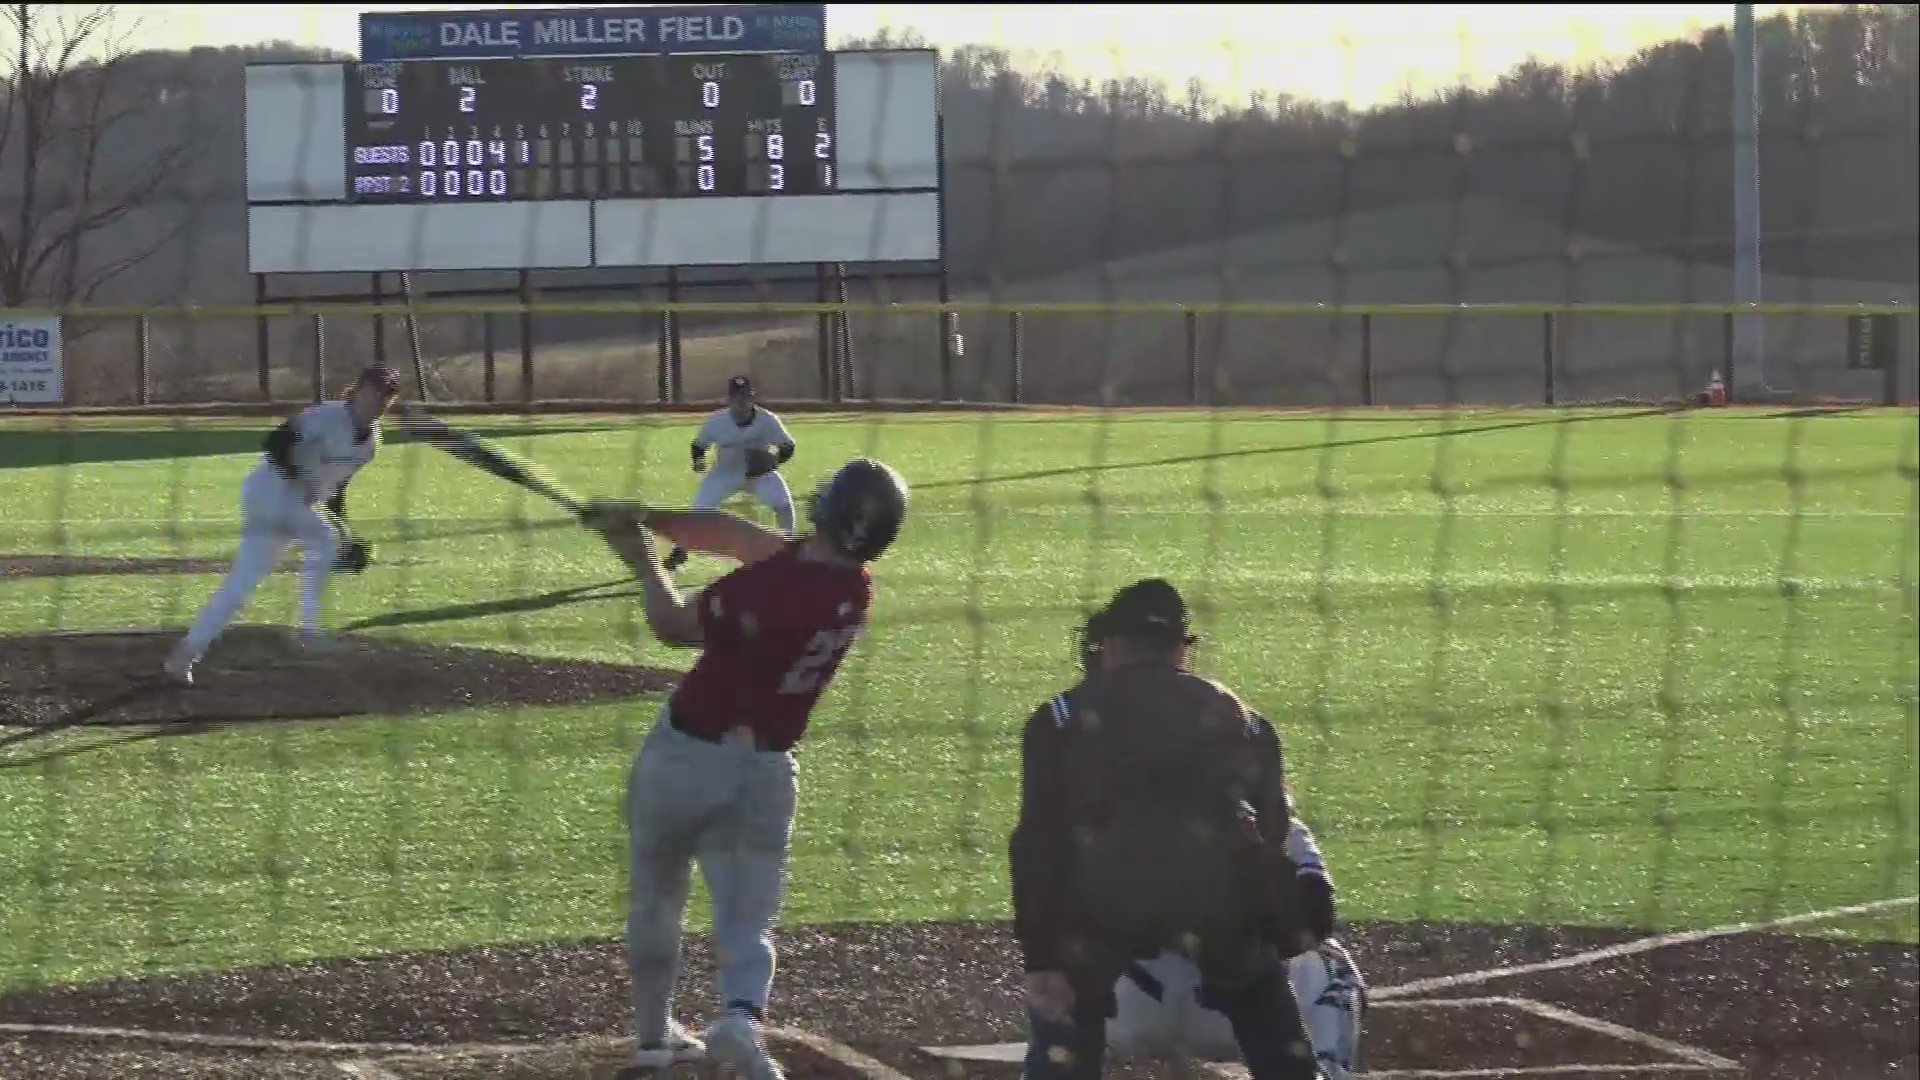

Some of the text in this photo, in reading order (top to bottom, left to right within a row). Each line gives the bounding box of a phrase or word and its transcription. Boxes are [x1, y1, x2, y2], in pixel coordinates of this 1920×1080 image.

[440, 20, 520, 47] DALE
[533, 18, 646, 45] MILLER
[657, 16, 746, 42] FIELD
[448, 66, 486, 85] BALL
[563, 64, 614, 83] STRIKE
[692, 63, 727, 80] OUT
[381, 88, 399, 114] 0
[458, 86, 476, 112] 2
[580, 84, 597, 110] 2
[702, 81, 720, 108] 0
[798, 80, 816, 106] 0
[674, 119, 714, 135] RUNS
[747, 117, 783, 133] HITS
[354, 140, 530, 166] GUESTS 0 0 0 4 1
[697, 135, 714, 162] 5
[766, 134, 784, 160] 8
[814, 133, 831, 158] 2
[420, 170, 437, 196] 0
[443, 170, 461, 196] 0
[467, 170, 485, 196] 0
[490, 170, 507, 196] 0
[698, 165, 715, 191] 0
[769, 164, 784, 190] 3
[823, 163, 832, 187] 1
